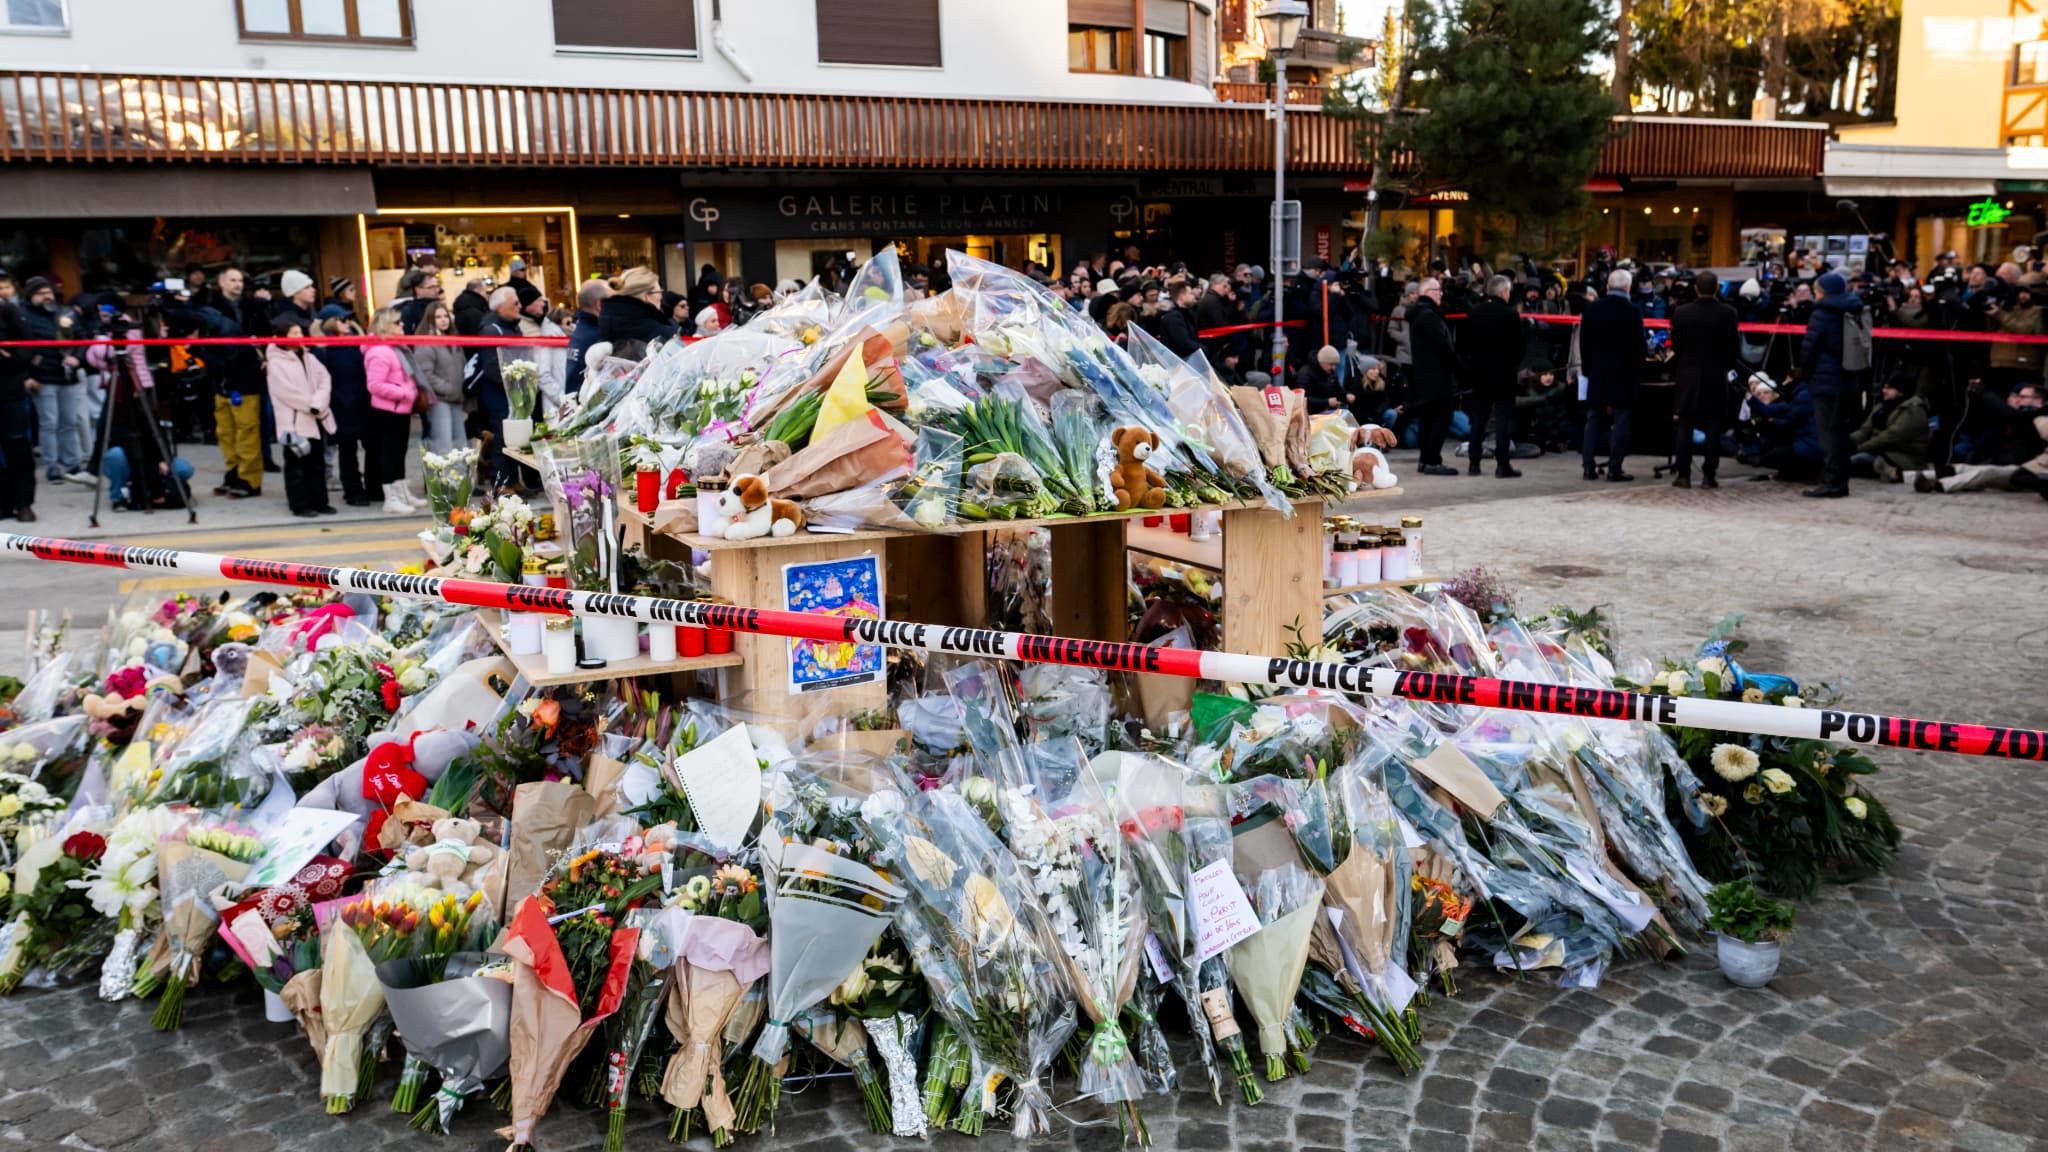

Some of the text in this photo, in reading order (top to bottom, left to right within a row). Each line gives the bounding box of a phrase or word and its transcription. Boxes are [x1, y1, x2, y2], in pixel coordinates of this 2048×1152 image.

[778, 193, 1062, 216] GALERIE PLATINI
[811, 221, 856, 232] CRANS
[862, 220, 925, 232] MONTANA
[232, 558, 440, 596] POLICE ZONE INTERDITE
[506, 585, 759, 629] POLICE ZONE INTERDITE
[843, 617, 1161, 671] POLICE ZONE INTERDITE
[1267, 657, 1678, 724] POLICE ZONE INTERDITE
[1819, 711, 2048, 762] POLICE ZO
